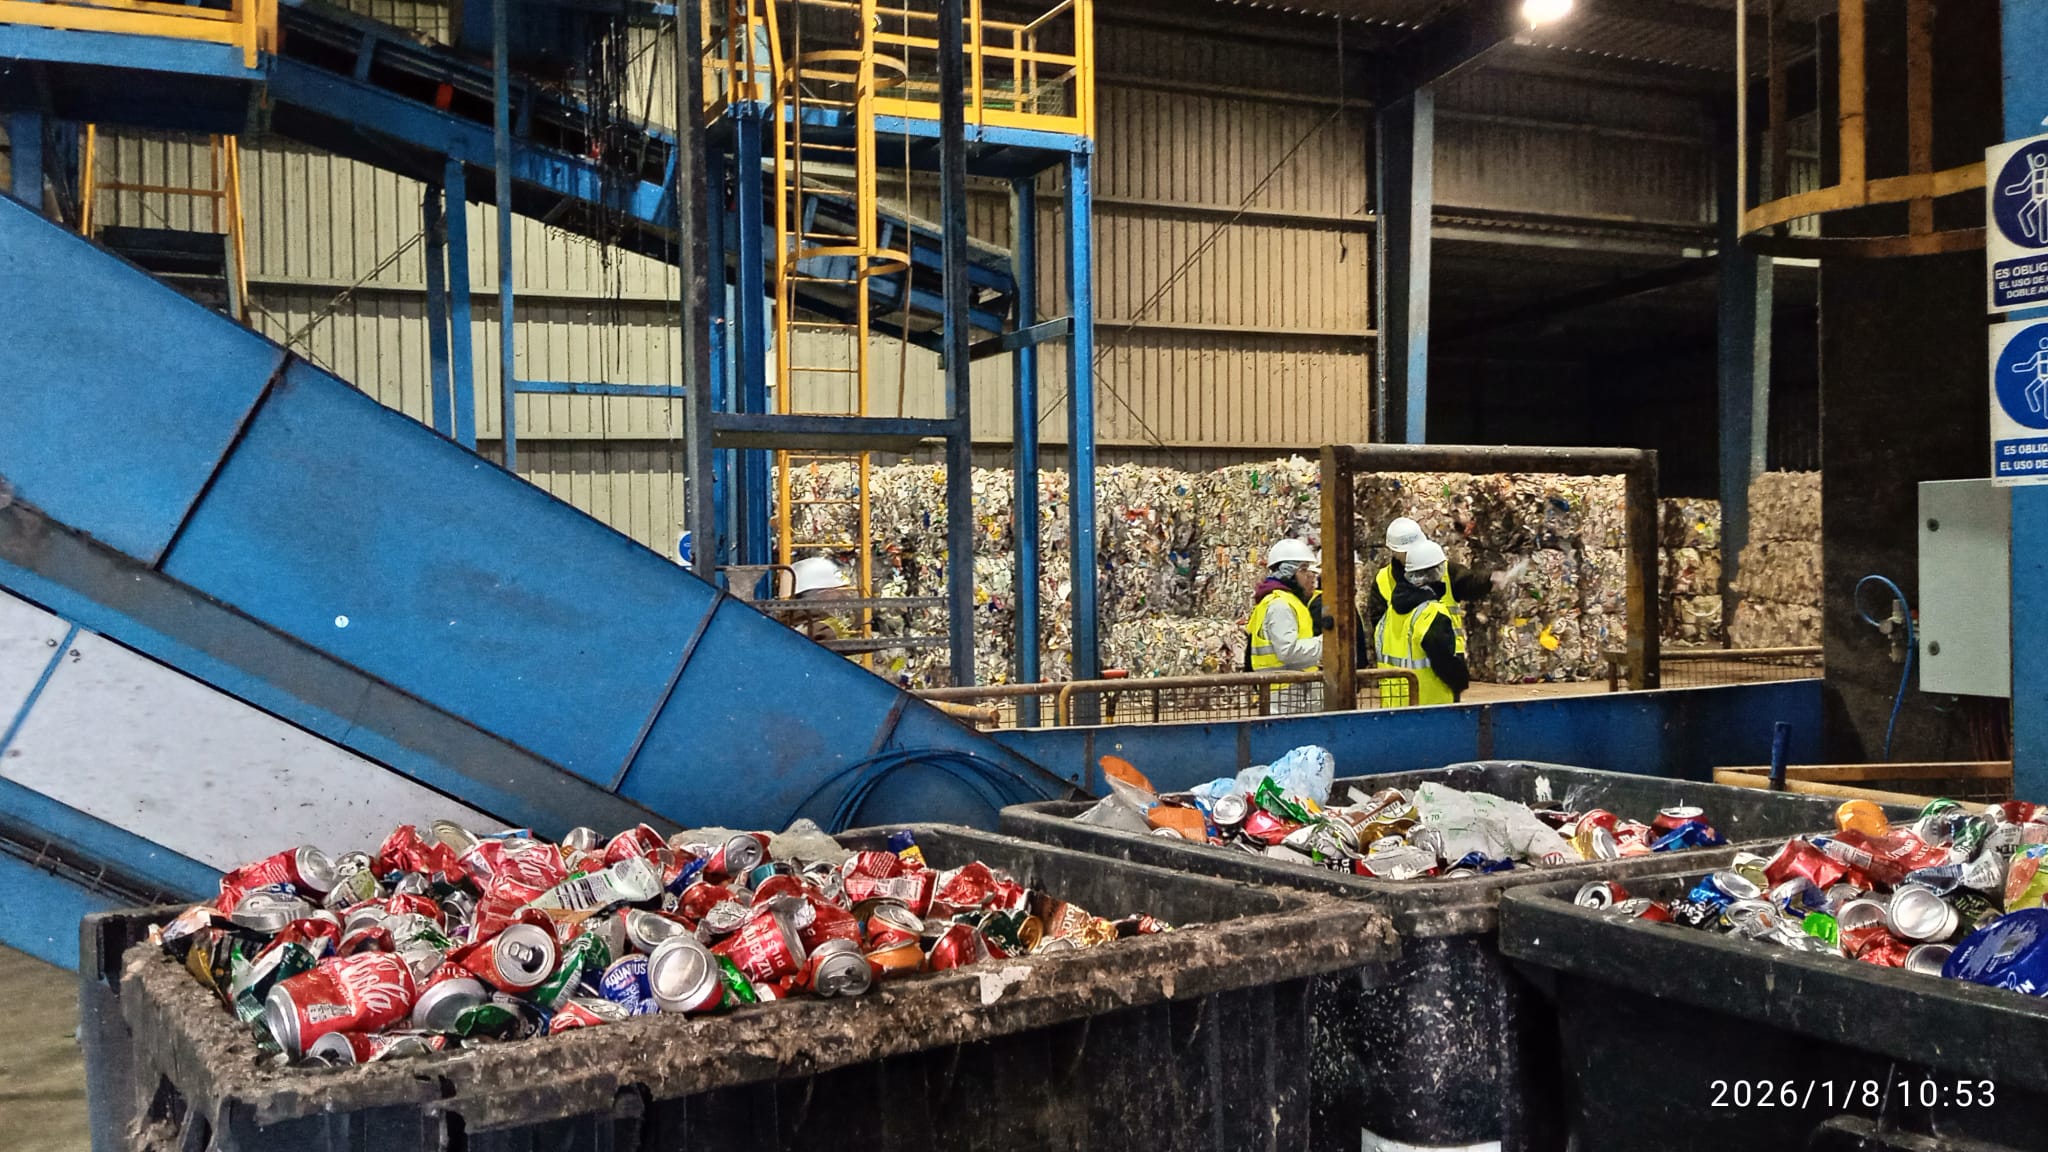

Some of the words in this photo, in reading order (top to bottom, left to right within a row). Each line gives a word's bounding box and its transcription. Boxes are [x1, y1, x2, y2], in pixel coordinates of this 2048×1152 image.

[1995, 268, 2010, 280] ES
[1999, 281, 2010, 290] EL
[2011, 278, 2031, 288] USO
[2032, 275, 2046, 285] DE
[2006, 286, 2037, 299] DOBLE
[2004, 445, 2017, 455] ES
[2000, 461, 2012, 471] EL
[2013, 460, 2033, 470] USO
[2035, 459, 2048, 469] DE
[436, 967, 474, 978] PILS
